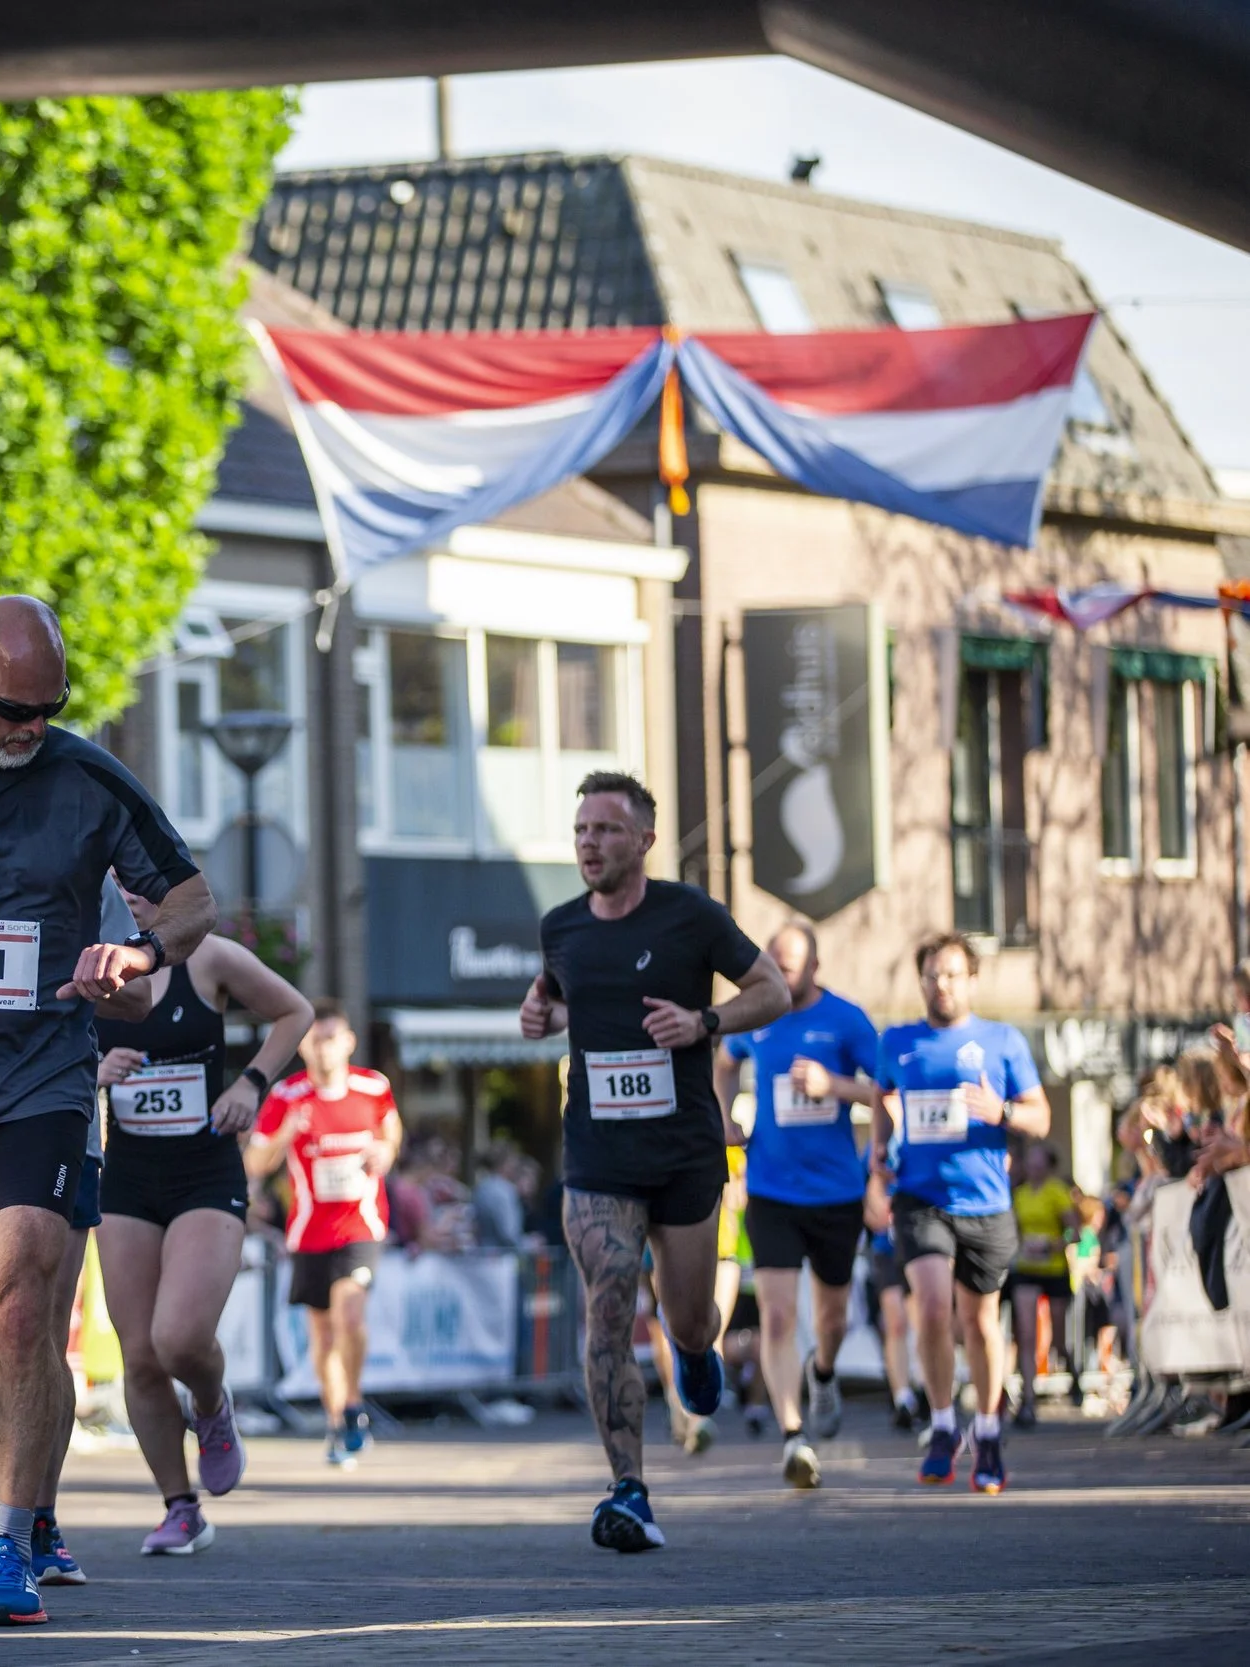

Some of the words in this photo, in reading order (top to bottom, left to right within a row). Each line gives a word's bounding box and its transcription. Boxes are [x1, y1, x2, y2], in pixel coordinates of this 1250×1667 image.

[606, 1072, 652, 1097] 188
[134, 1088, 182, 1114] 253
[53, 1163, 68, 1198] FUSION
